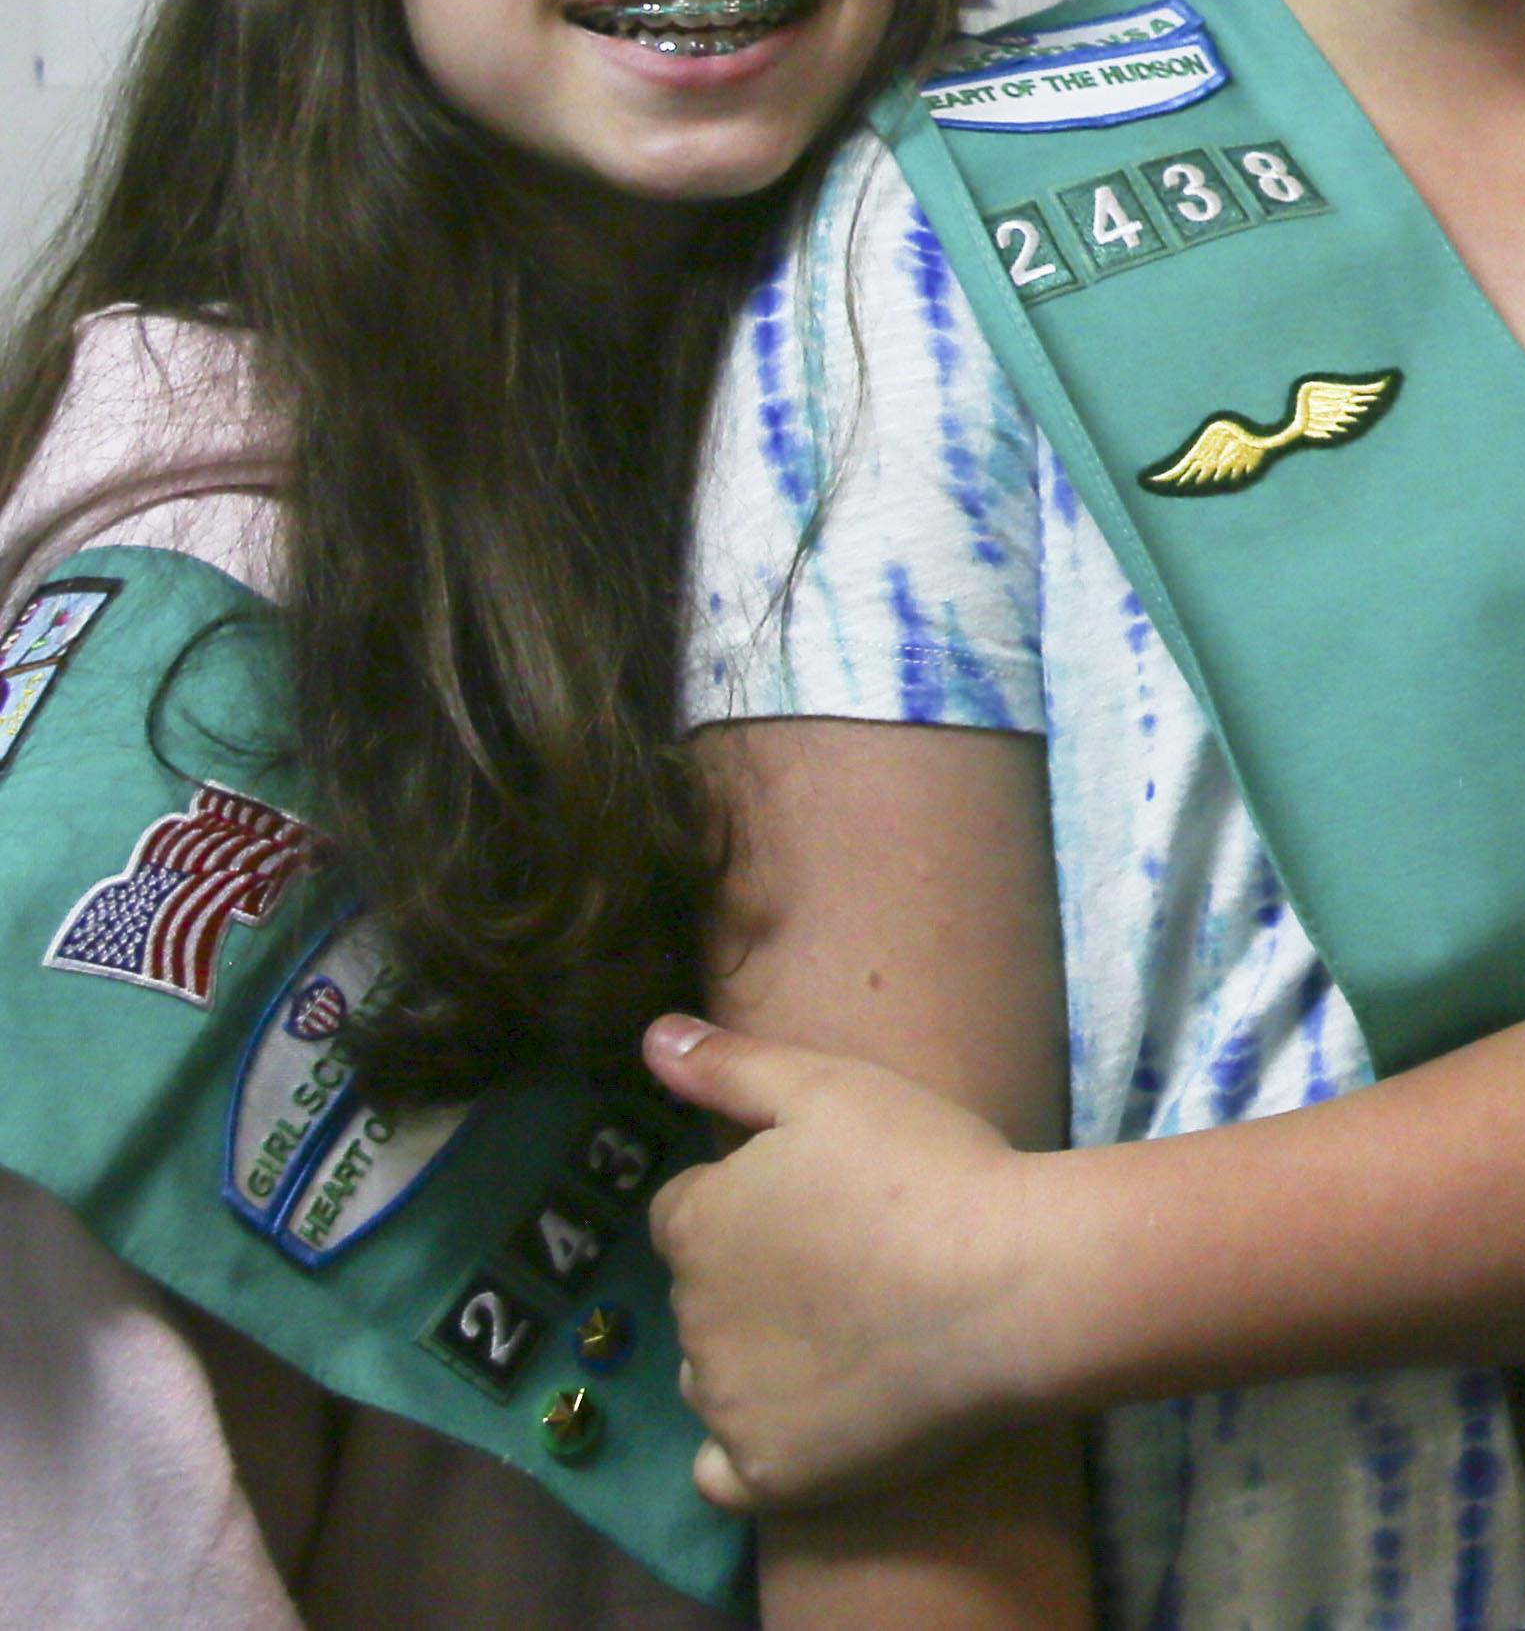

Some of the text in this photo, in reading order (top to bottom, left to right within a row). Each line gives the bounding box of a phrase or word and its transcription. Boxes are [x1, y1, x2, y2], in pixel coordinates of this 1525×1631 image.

[927, 52, 1208, 111] EART OF THE HUDSON
[995, 150, 1304, 288] 2438
[247, 1117, 313, 1198] GIRL
[299, 1137, 374, 1247] HEART
[363, 1115, 397, 1145] O
[460, 1128, 646, 1365] 243
